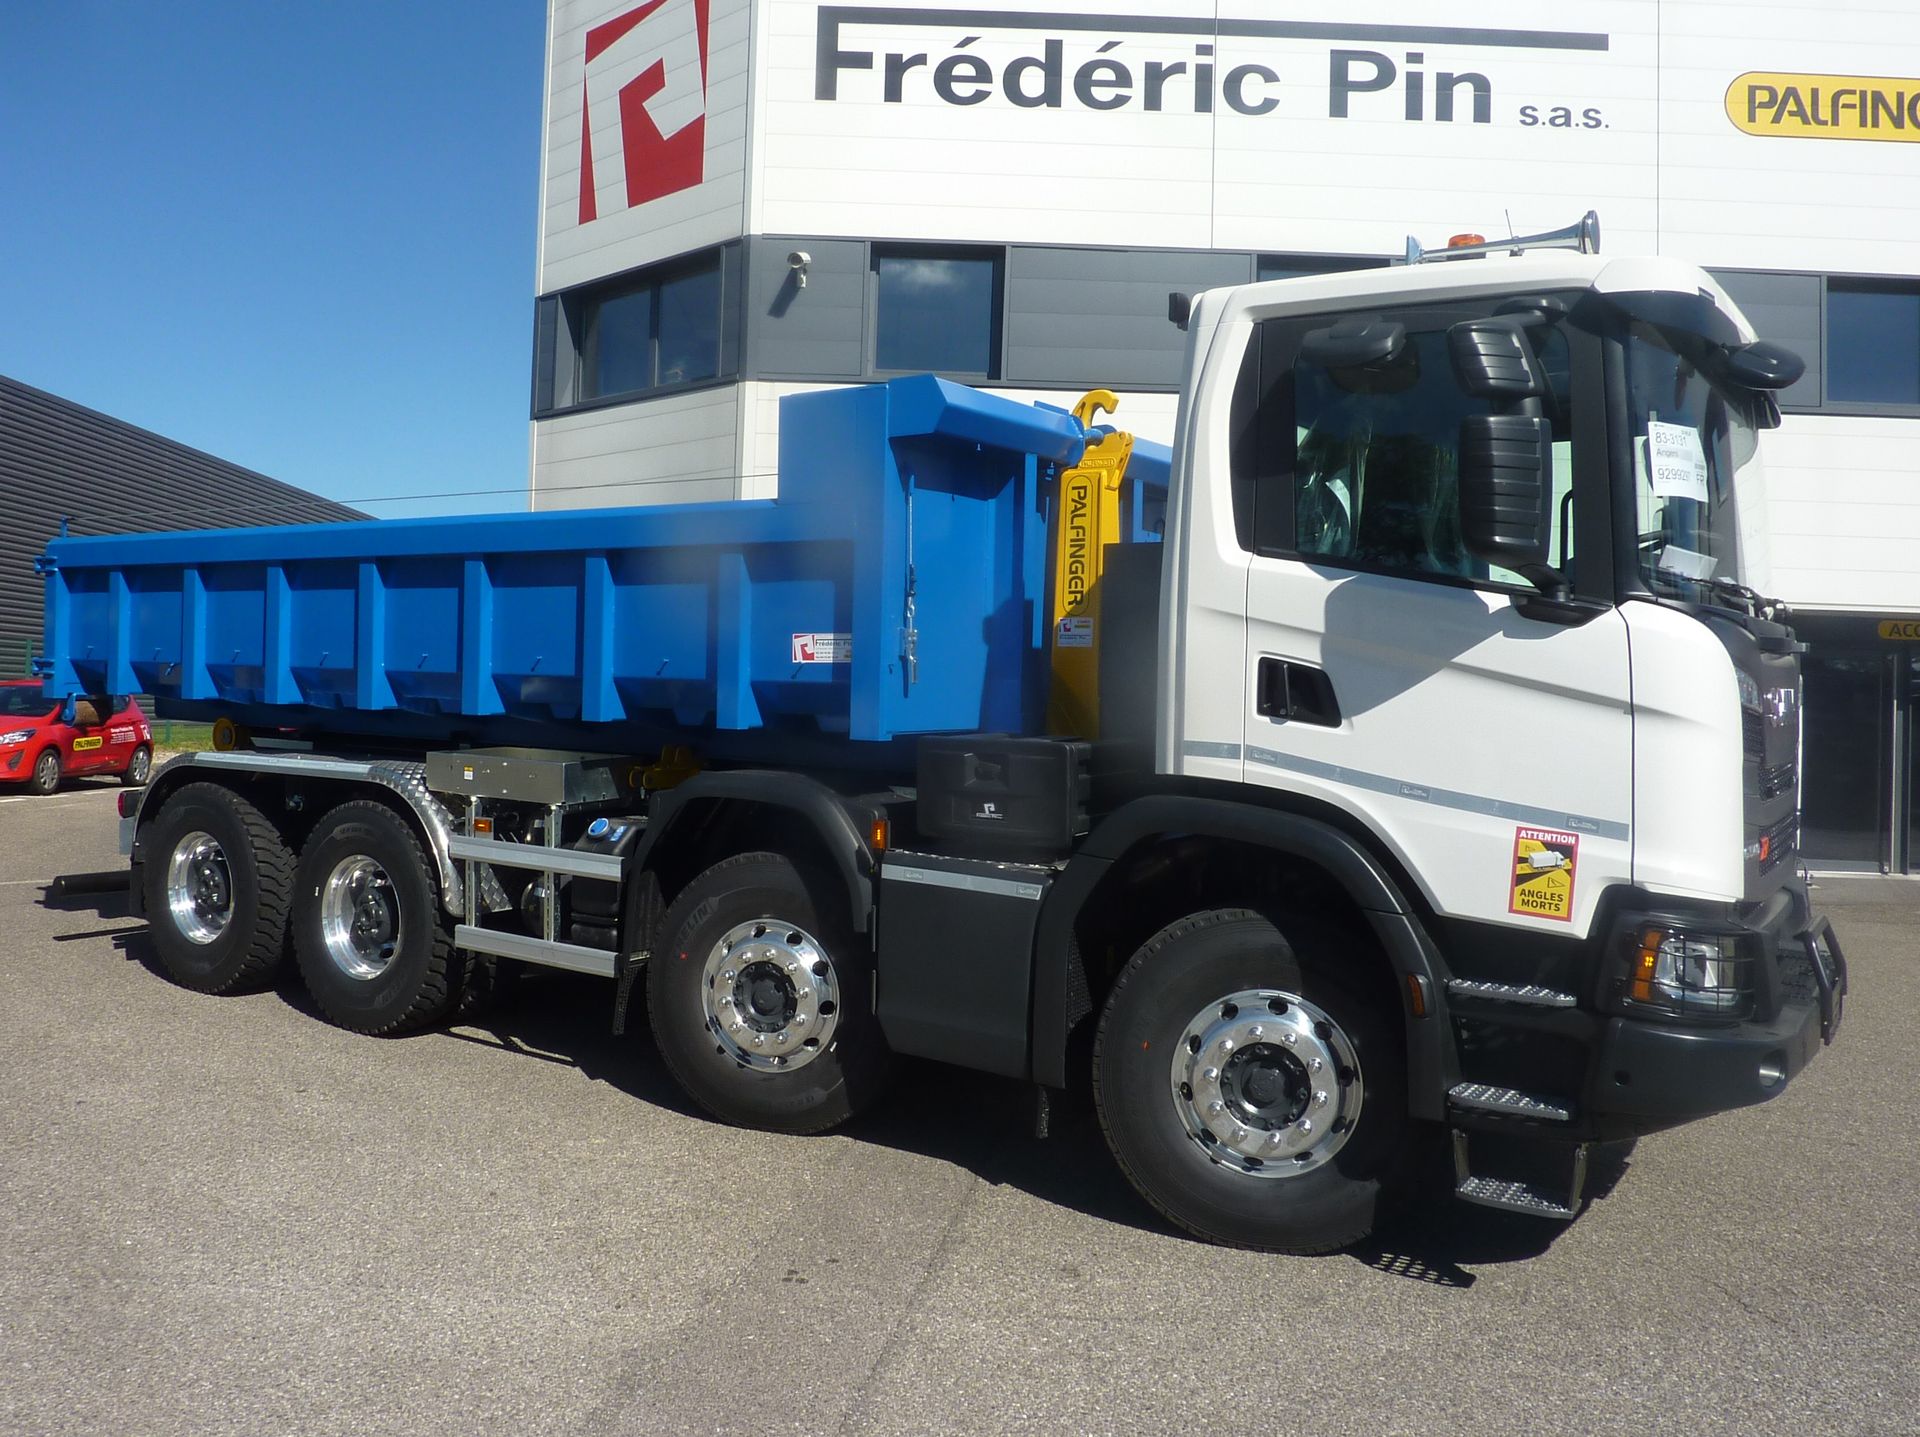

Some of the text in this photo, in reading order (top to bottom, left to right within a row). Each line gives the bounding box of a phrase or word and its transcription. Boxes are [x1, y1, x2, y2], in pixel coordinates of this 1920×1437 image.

[816, 6, 1610, 130] Frédéric Pin s.a.s.
[1067, 485, 1087, 605] PALFINGER
[1520, 829, 1576, 844] ATTENTION
[1519, 888, 1564, 902] ANGLES
[1521, 898, 1561, 912] MORTS
